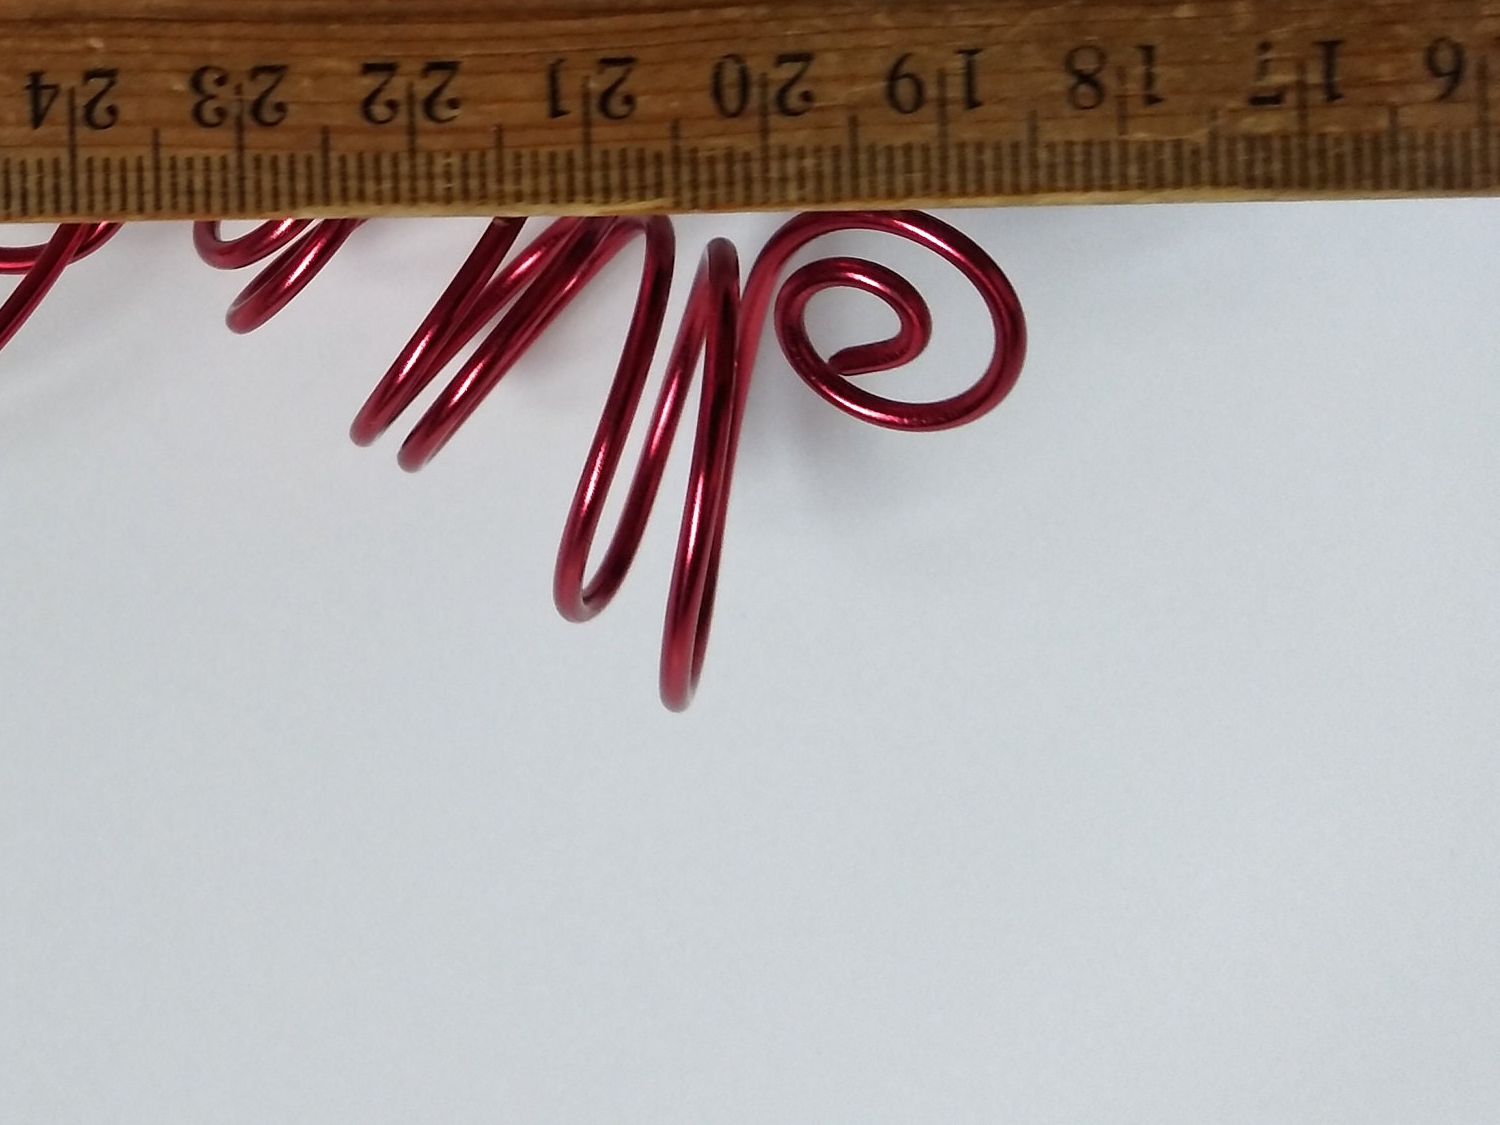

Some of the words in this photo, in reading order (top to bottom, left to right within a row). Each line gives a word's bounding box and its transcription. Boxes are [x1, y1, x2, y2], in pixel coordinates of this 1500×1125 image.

[25, 68, 119, 131] 24
[189, 65, 289, 127] 23
[360, 61, 461, 126] 22
[545, 56, 639, 121] 21
[710, 52, 817, 118] 20
[885, 47, 983, 114] 19
[1064, 44, 1164, 110] 18
